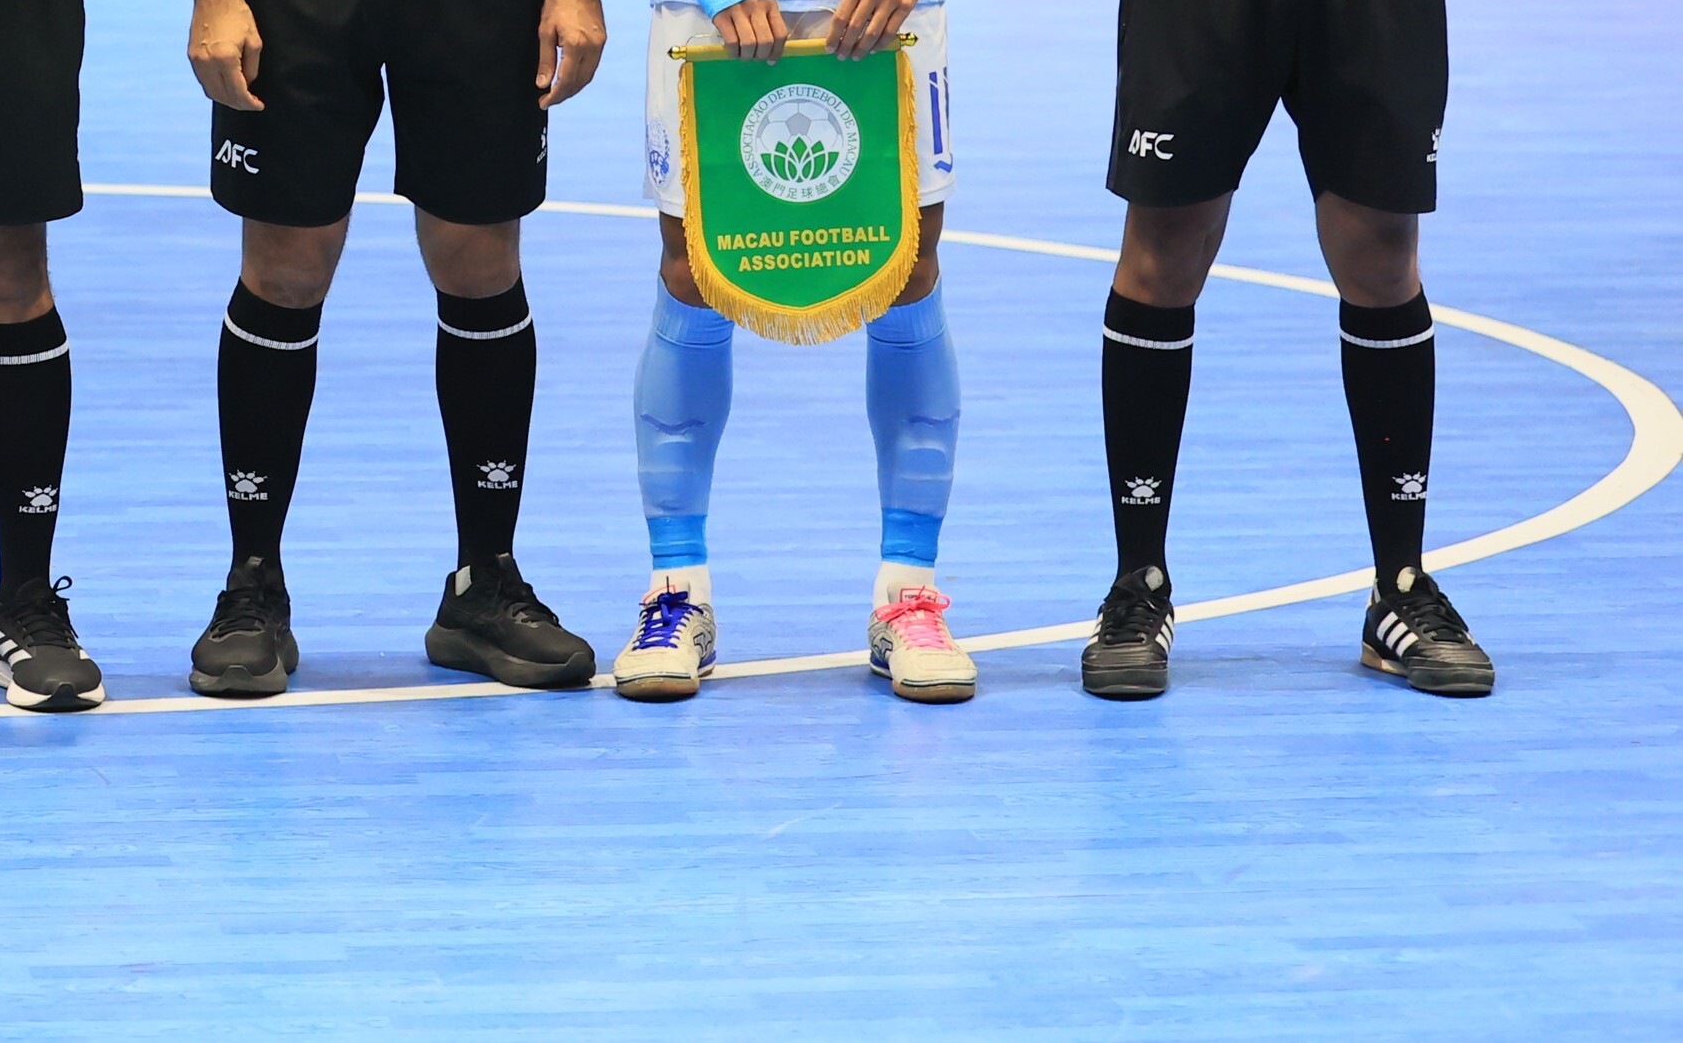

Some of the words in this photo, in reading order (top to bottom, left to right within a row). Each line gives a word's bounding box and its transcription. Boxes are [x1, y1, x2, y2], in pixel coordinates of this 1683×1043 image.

[769, 88, 786, 105] DE
[788, 86, 842, 113] FUTEBOL
[840, 110, 856, 129] DE
[839, 132, 858, 177] MACAU
[1128, 129, 1174, 160] AFC
[215, 139, 259, 174] AFC
[717, 231, 785, 251] MACAU
[789, 226, 891, 246] FOOTBALL
[738, 249, 870, 272] ASSOCIATION
[228, 490, 268, 501] KELME
[477, 480, 518, 490] KELME
[18, 504, 57, 514] KELME
[1121, 495, 1161, 505] KELME
